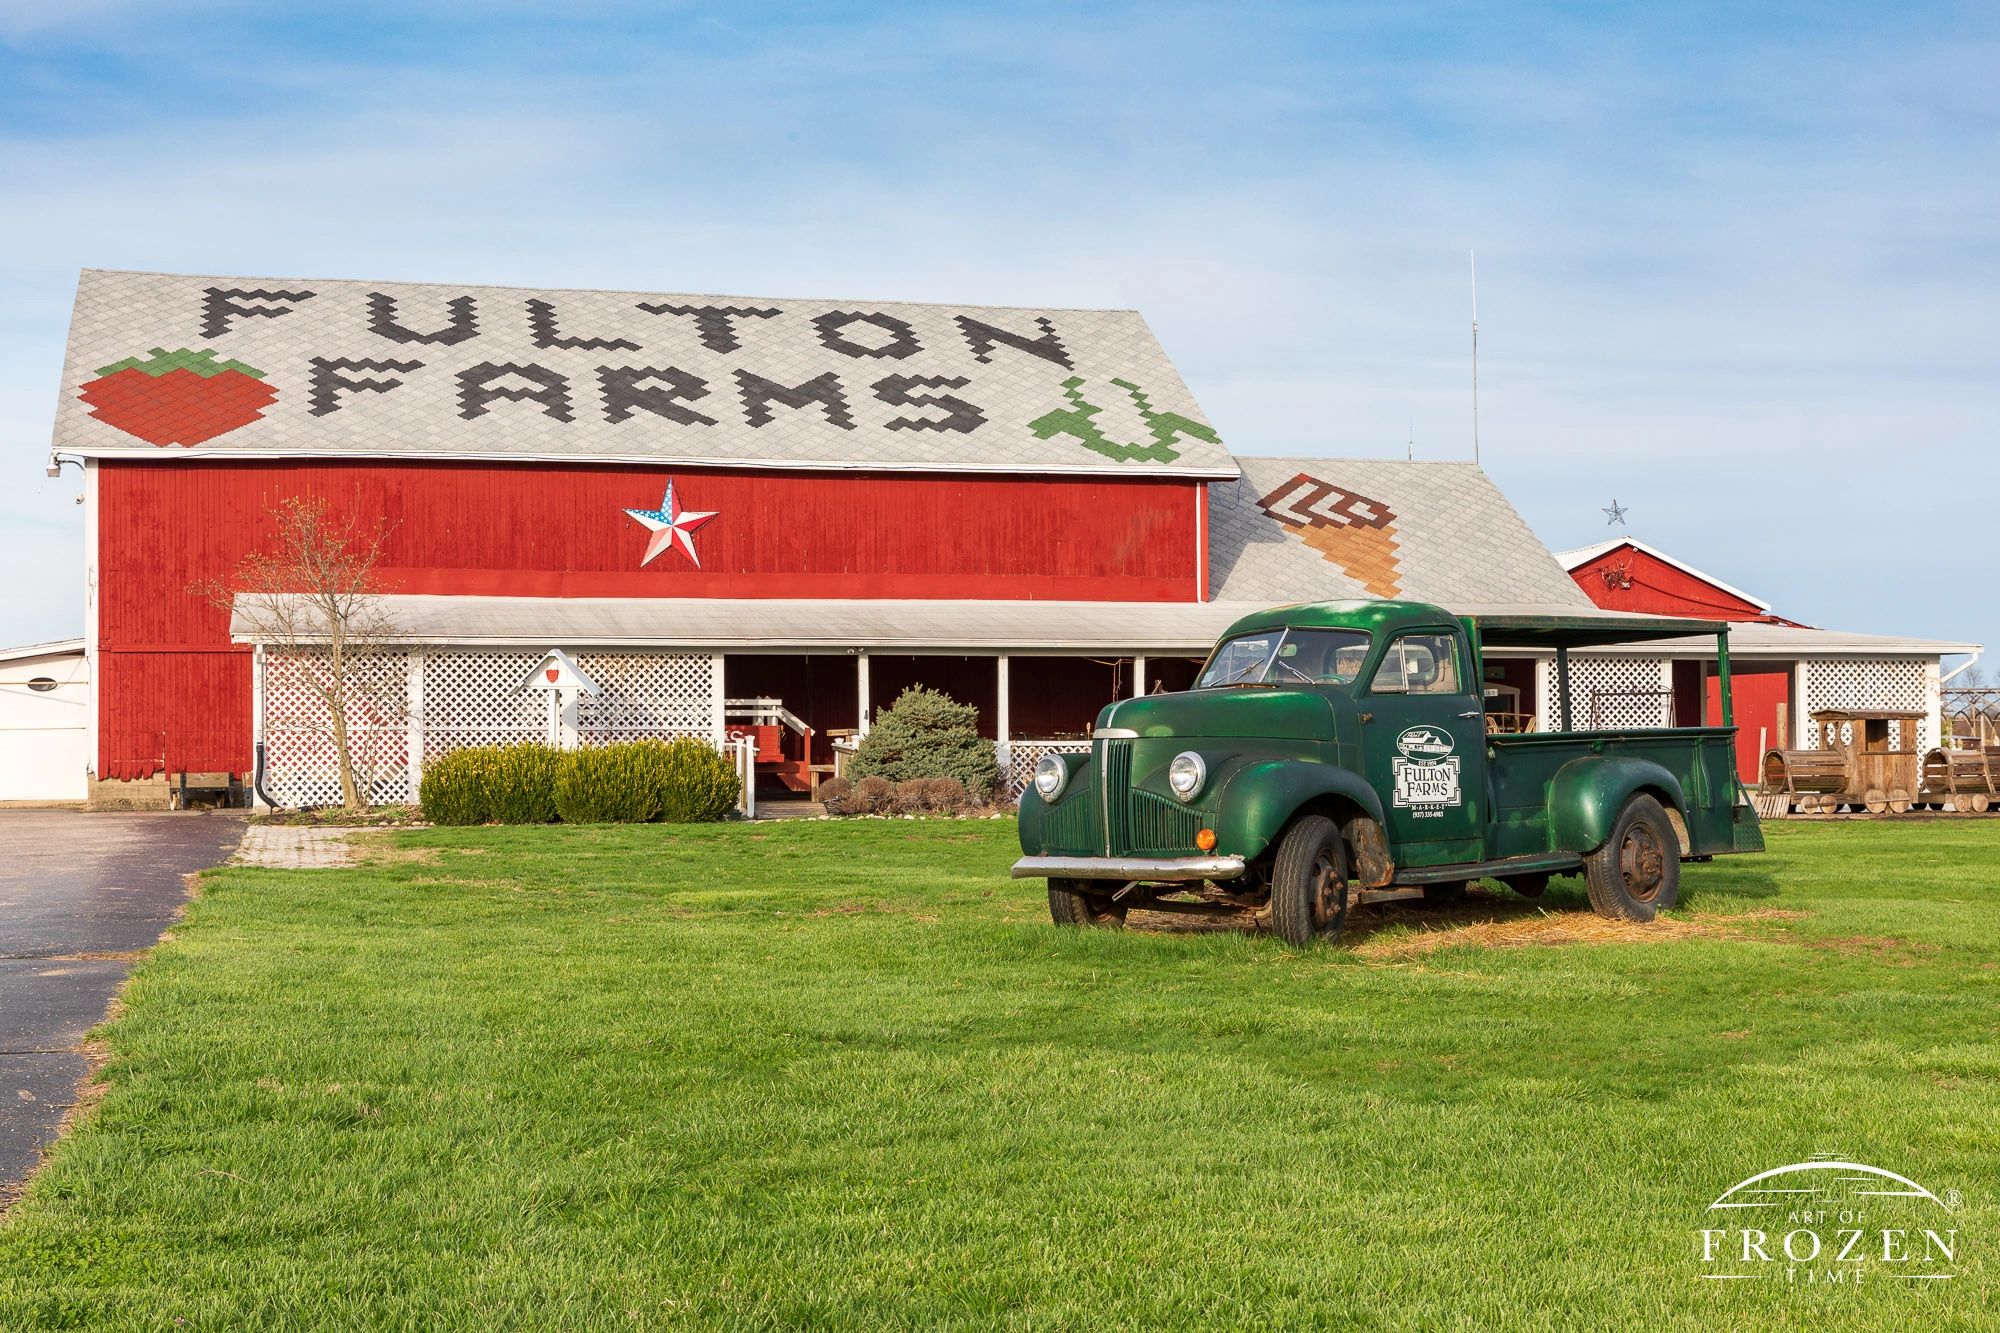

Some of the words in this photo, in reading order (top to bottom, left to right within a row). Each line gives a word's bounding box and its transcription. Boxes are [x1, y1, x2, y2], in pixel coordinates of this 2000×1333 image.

[199, 287, 1075, 371] FULTON
[308, 356, 989, 434] FARMS
[1404, 767, 1451, 782] FULTON
[1407, 782, 1448, 797] FARMS
